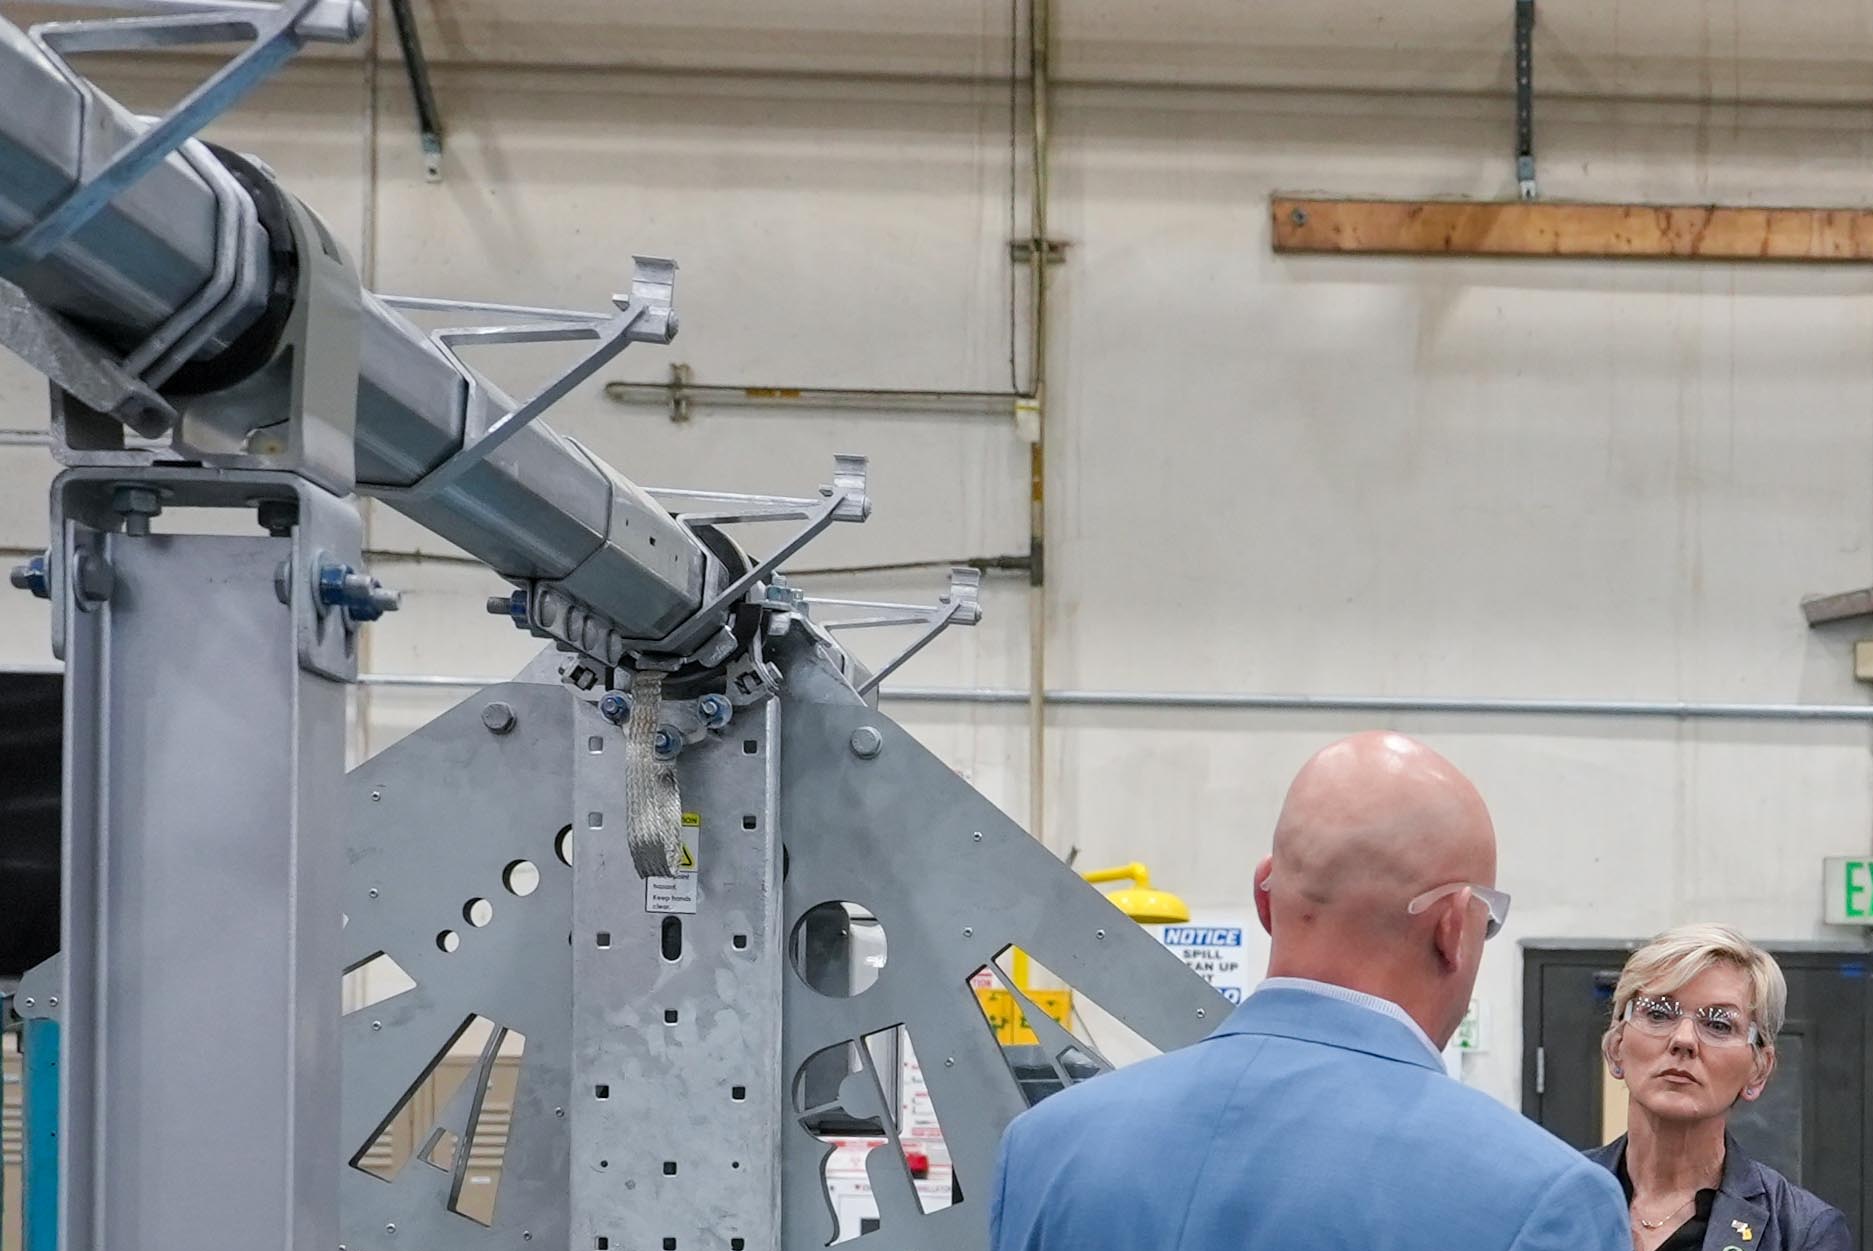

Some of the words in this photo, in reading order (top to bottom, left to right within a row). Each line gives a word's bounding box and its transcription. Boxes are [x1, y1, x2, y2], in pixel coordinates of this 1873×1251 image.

[1166, 928, 1239, 945] NOTICE
[1183, 949, 1224, 959] SPILL
[1219, 961, 1239, 972] UP
